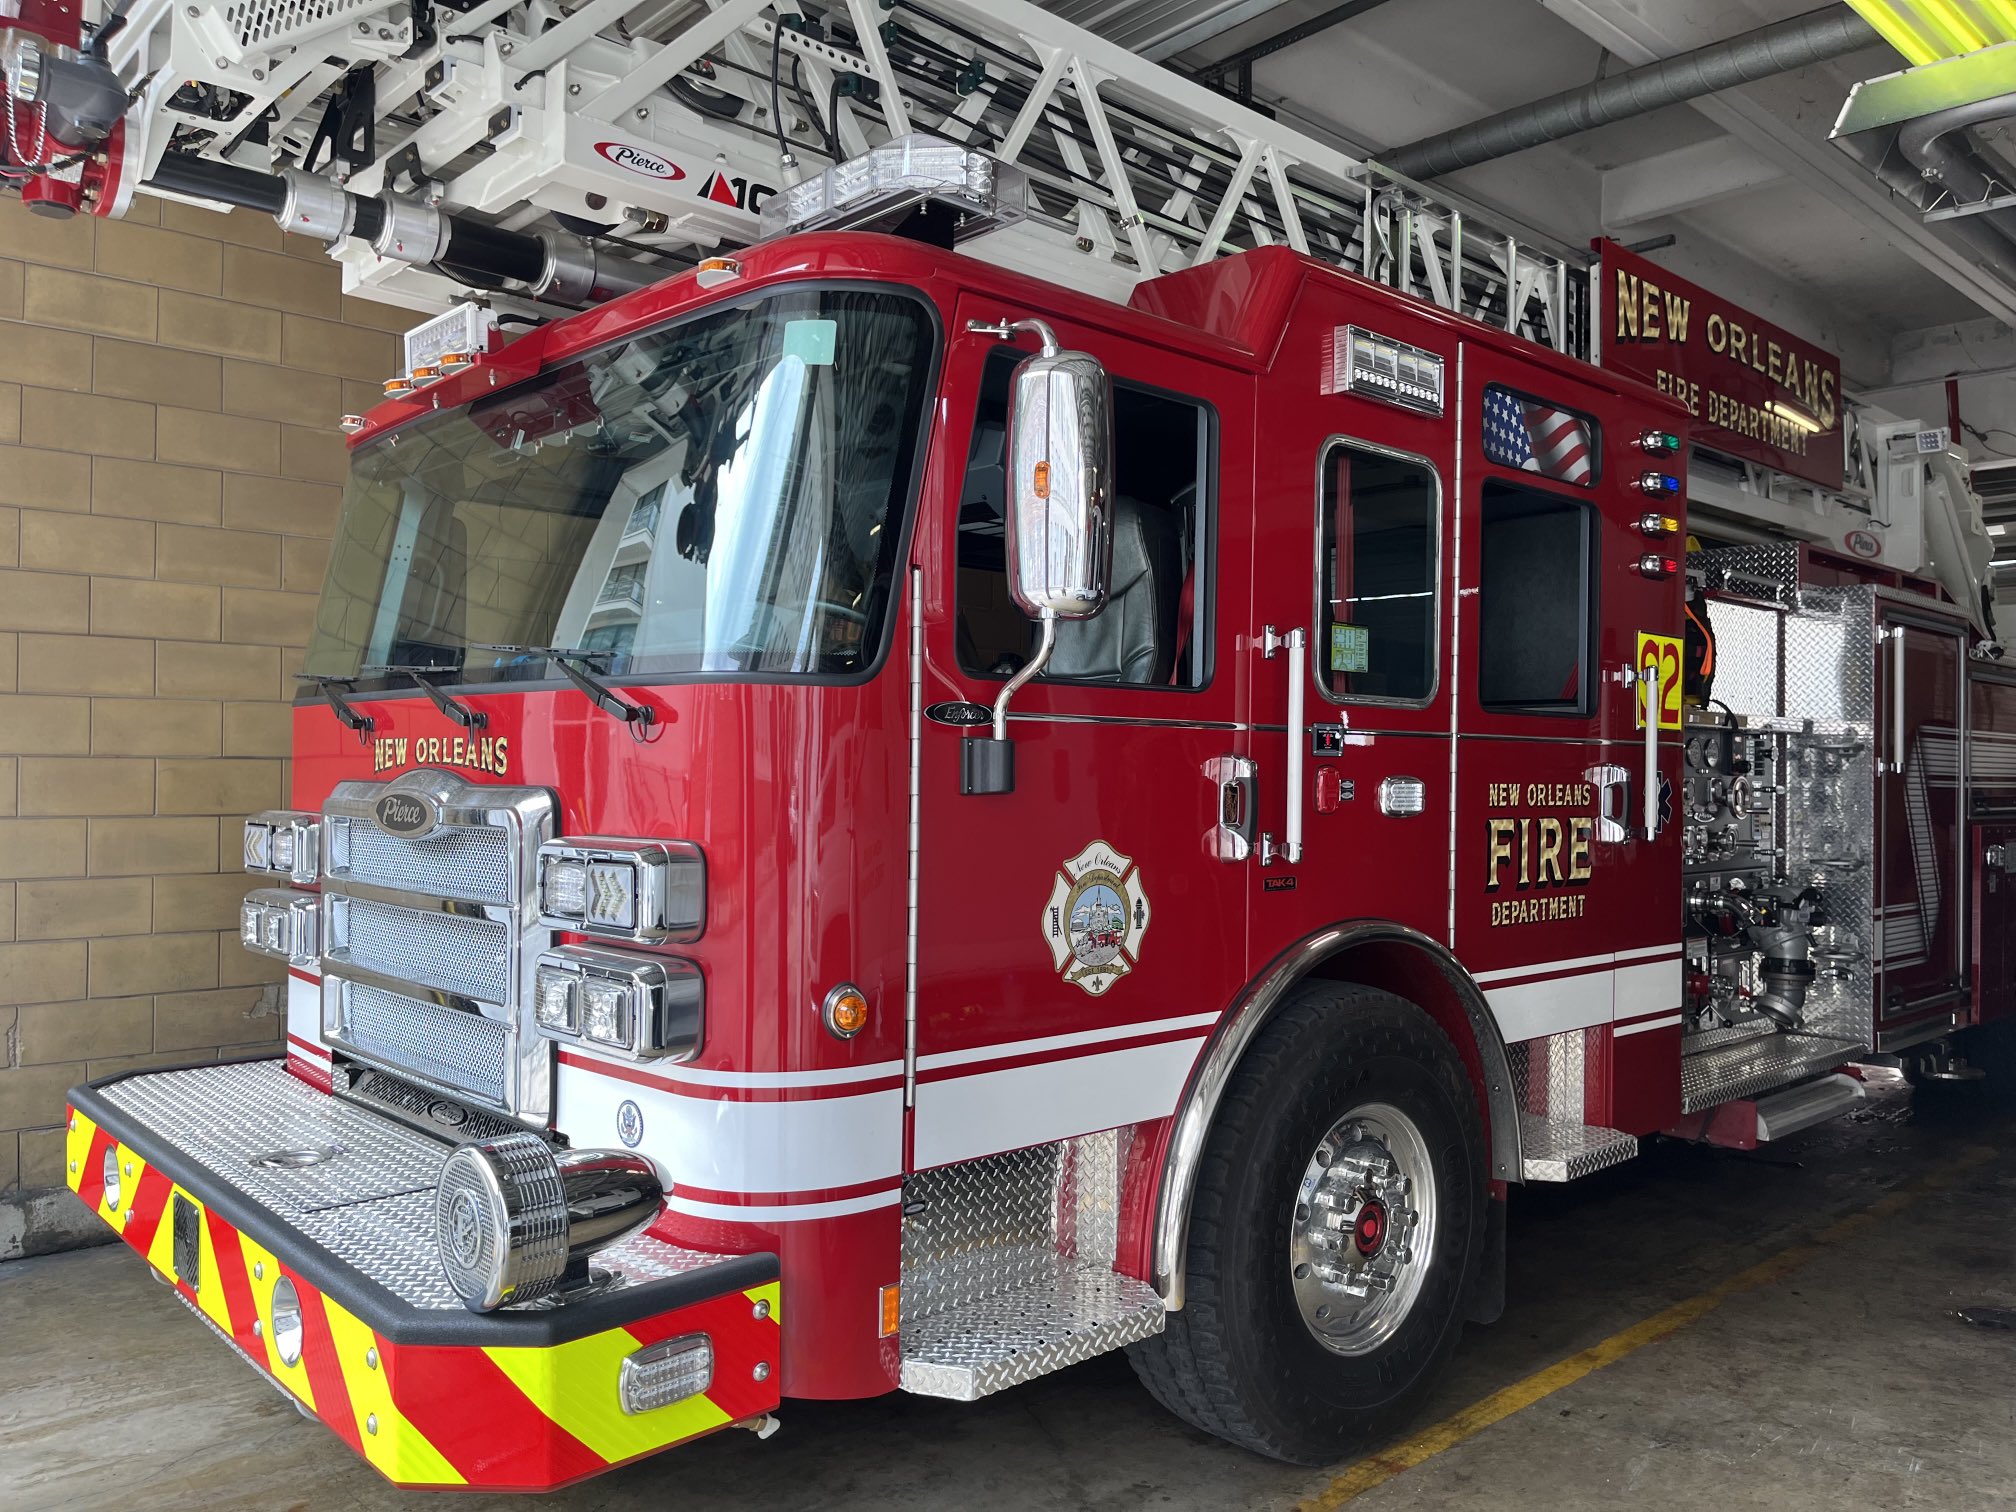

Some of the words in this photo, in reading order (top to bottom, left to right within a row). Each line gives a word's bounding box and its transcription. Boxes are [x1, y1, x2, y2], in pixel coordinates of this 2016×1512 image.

[615, 147, 665, 174] Pierce
[1616, 268, 1690, 343] NEW
[1706, 313, 1836, 430] ORLEANS
[1656, 369, 1699, 417] FIRE
[1708, 390, 1809, 457] DEPARTMENT
[374, 738, 408, 773] NEW
[415, 736, 508, 776] ORLEANS
[383, 797, 421, 825] Pierce
[1488, 783, 1521, 807] NEW
[1527, 783, 1591, 807] ORLEANS
[1073, 859, 1093, 877] New
[1094, 851, 1121, 875] Orleans
[1485, 816, 1592, 893] FIRE
[1491, 895, 1586, 927] DEPARTMENT
